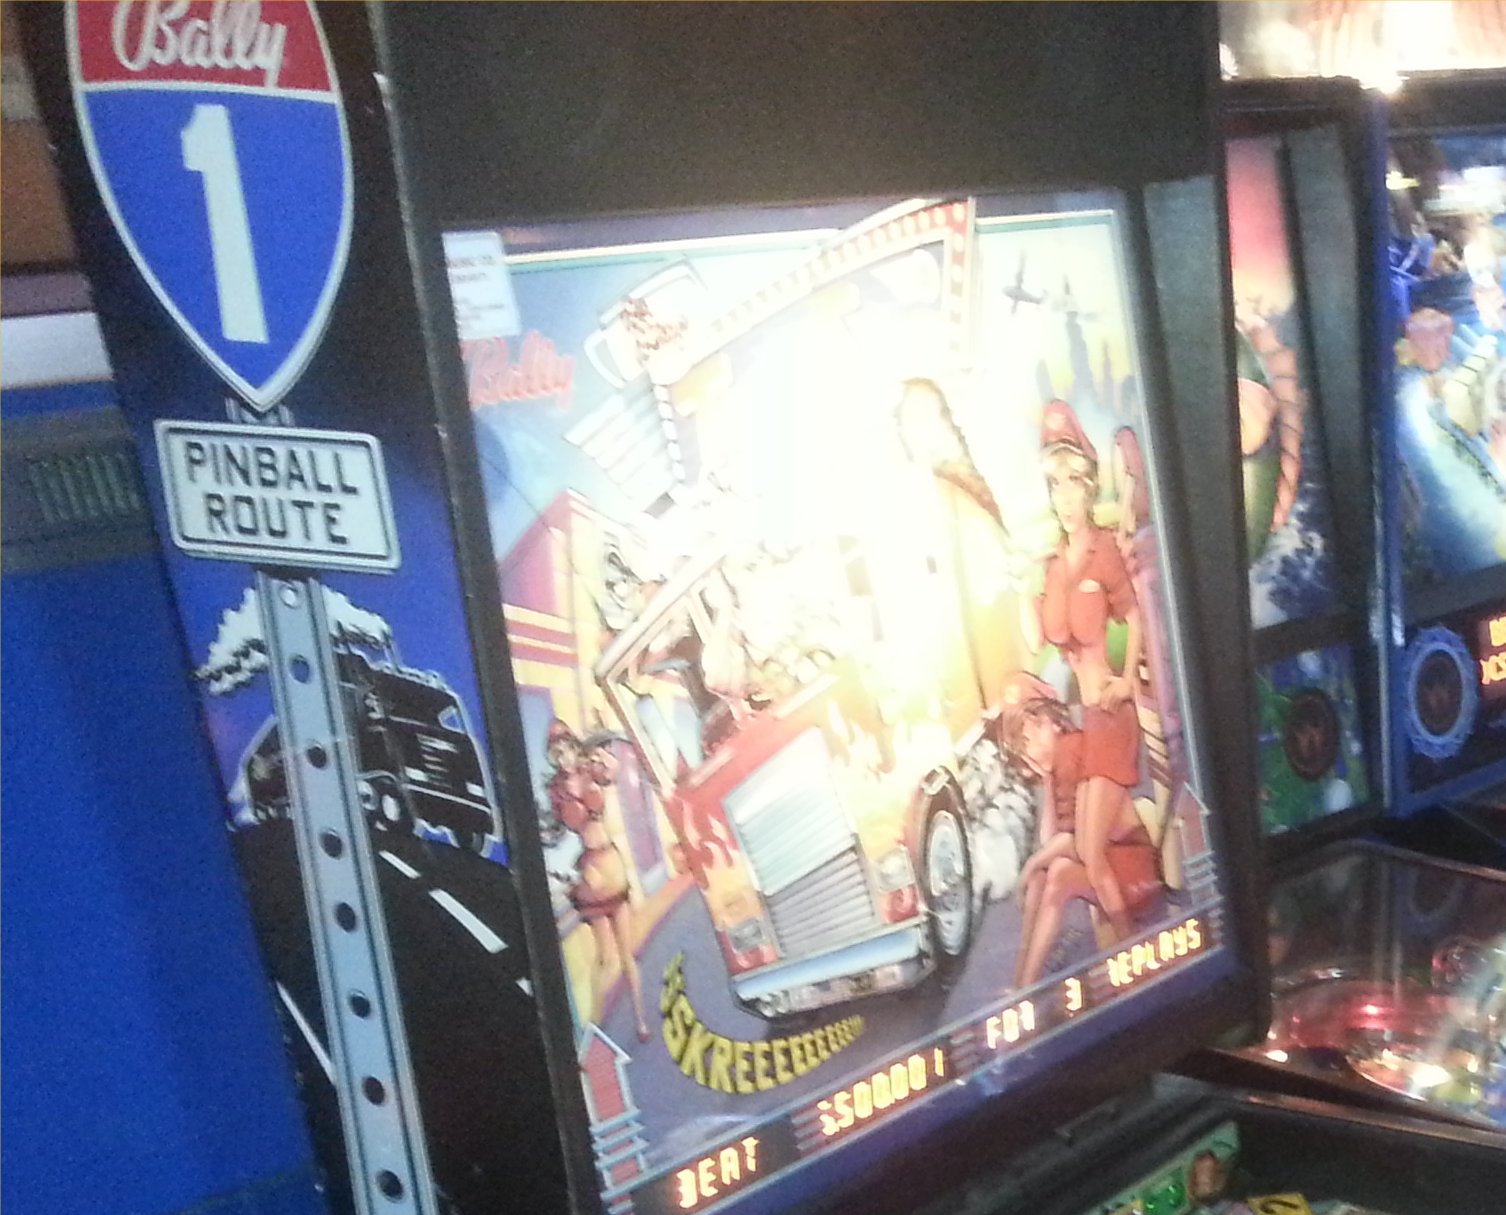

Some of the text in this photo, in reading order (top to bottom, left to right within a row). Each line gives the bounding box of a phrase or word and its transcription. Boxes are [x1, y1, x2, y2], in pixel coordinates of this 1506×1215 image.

[112, 0, 287, 88] Bally
[181, 105, 268, 344] 1
[184, 441, 359, 494] PINBALL
[205, 492, 348, 545] ROUTE
